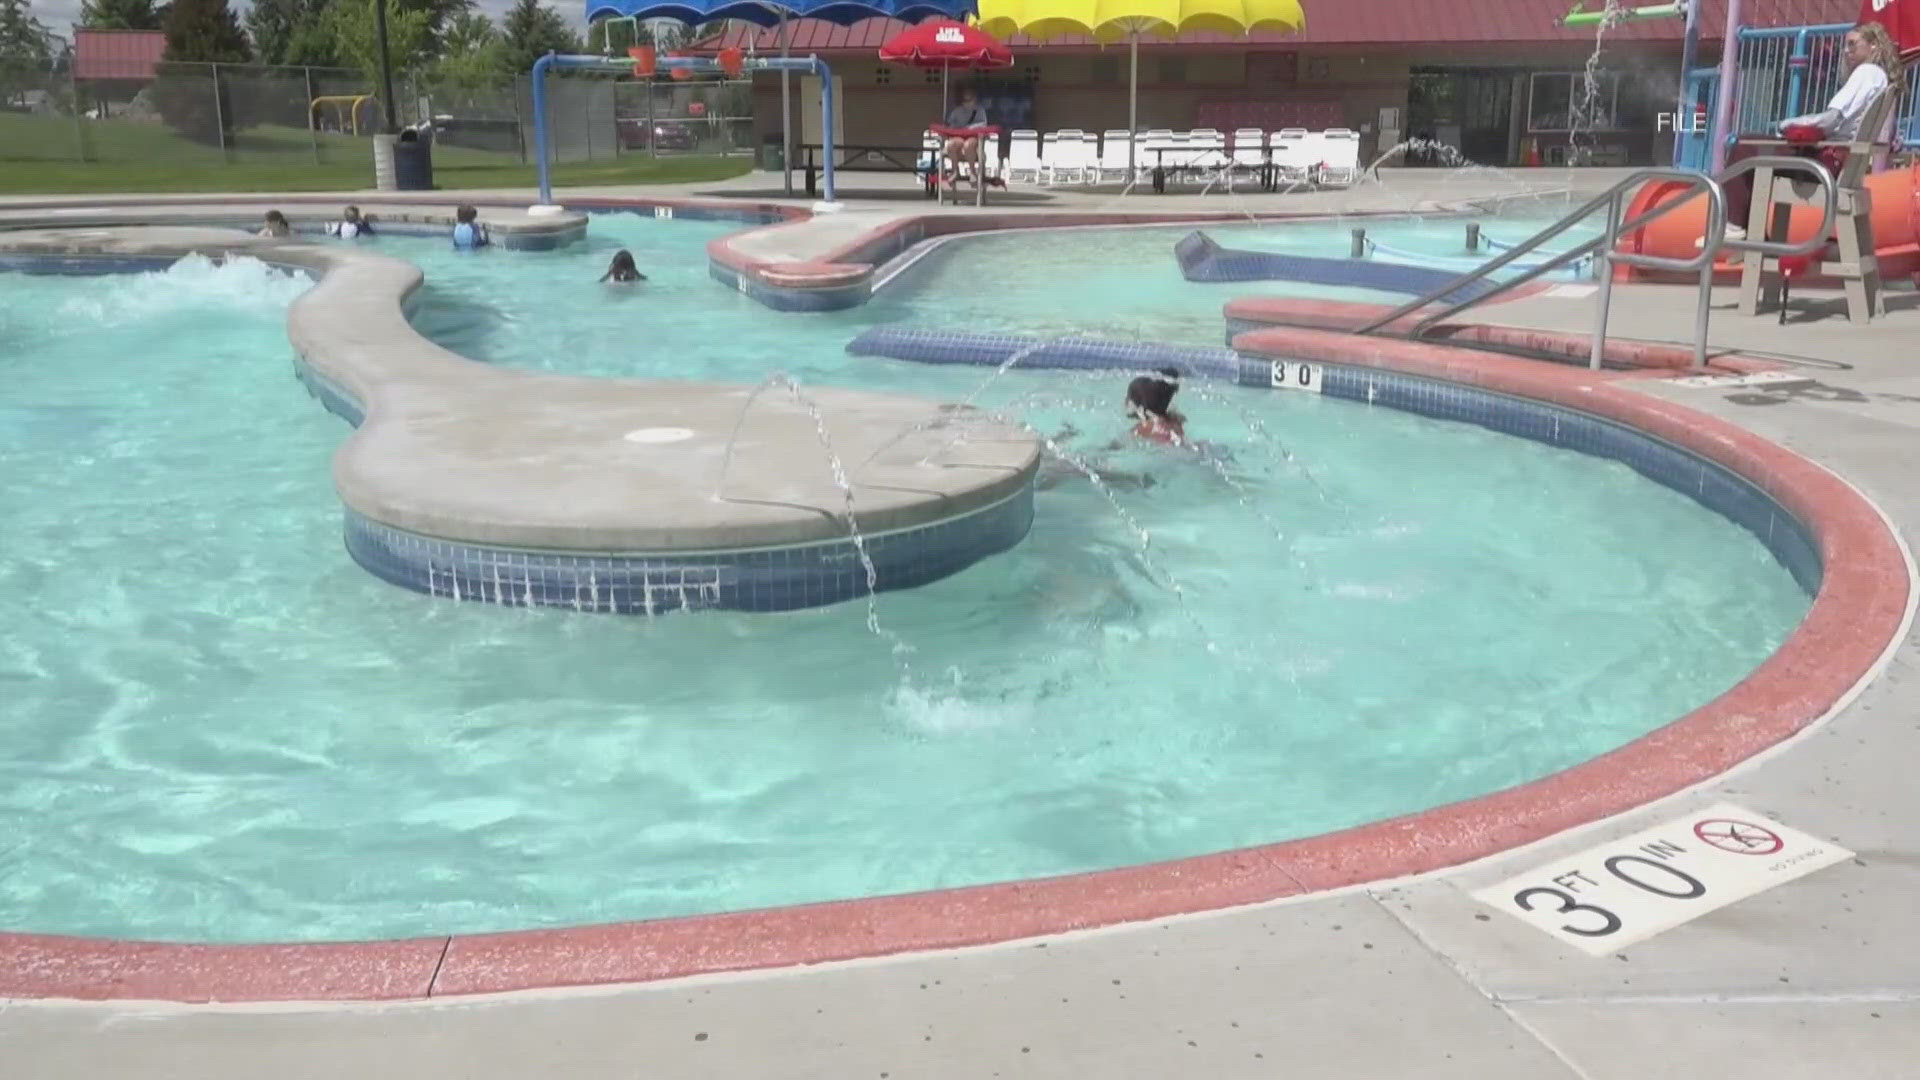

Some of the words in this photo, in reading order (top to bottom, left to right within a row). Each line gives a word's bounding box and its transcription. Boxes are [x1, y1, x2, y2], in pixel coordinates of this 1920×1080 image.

[1274, 361, 1285, 382] 3
[1552, 870, 1600, 893] FT
[1639, 839, 1688, 860] IN
